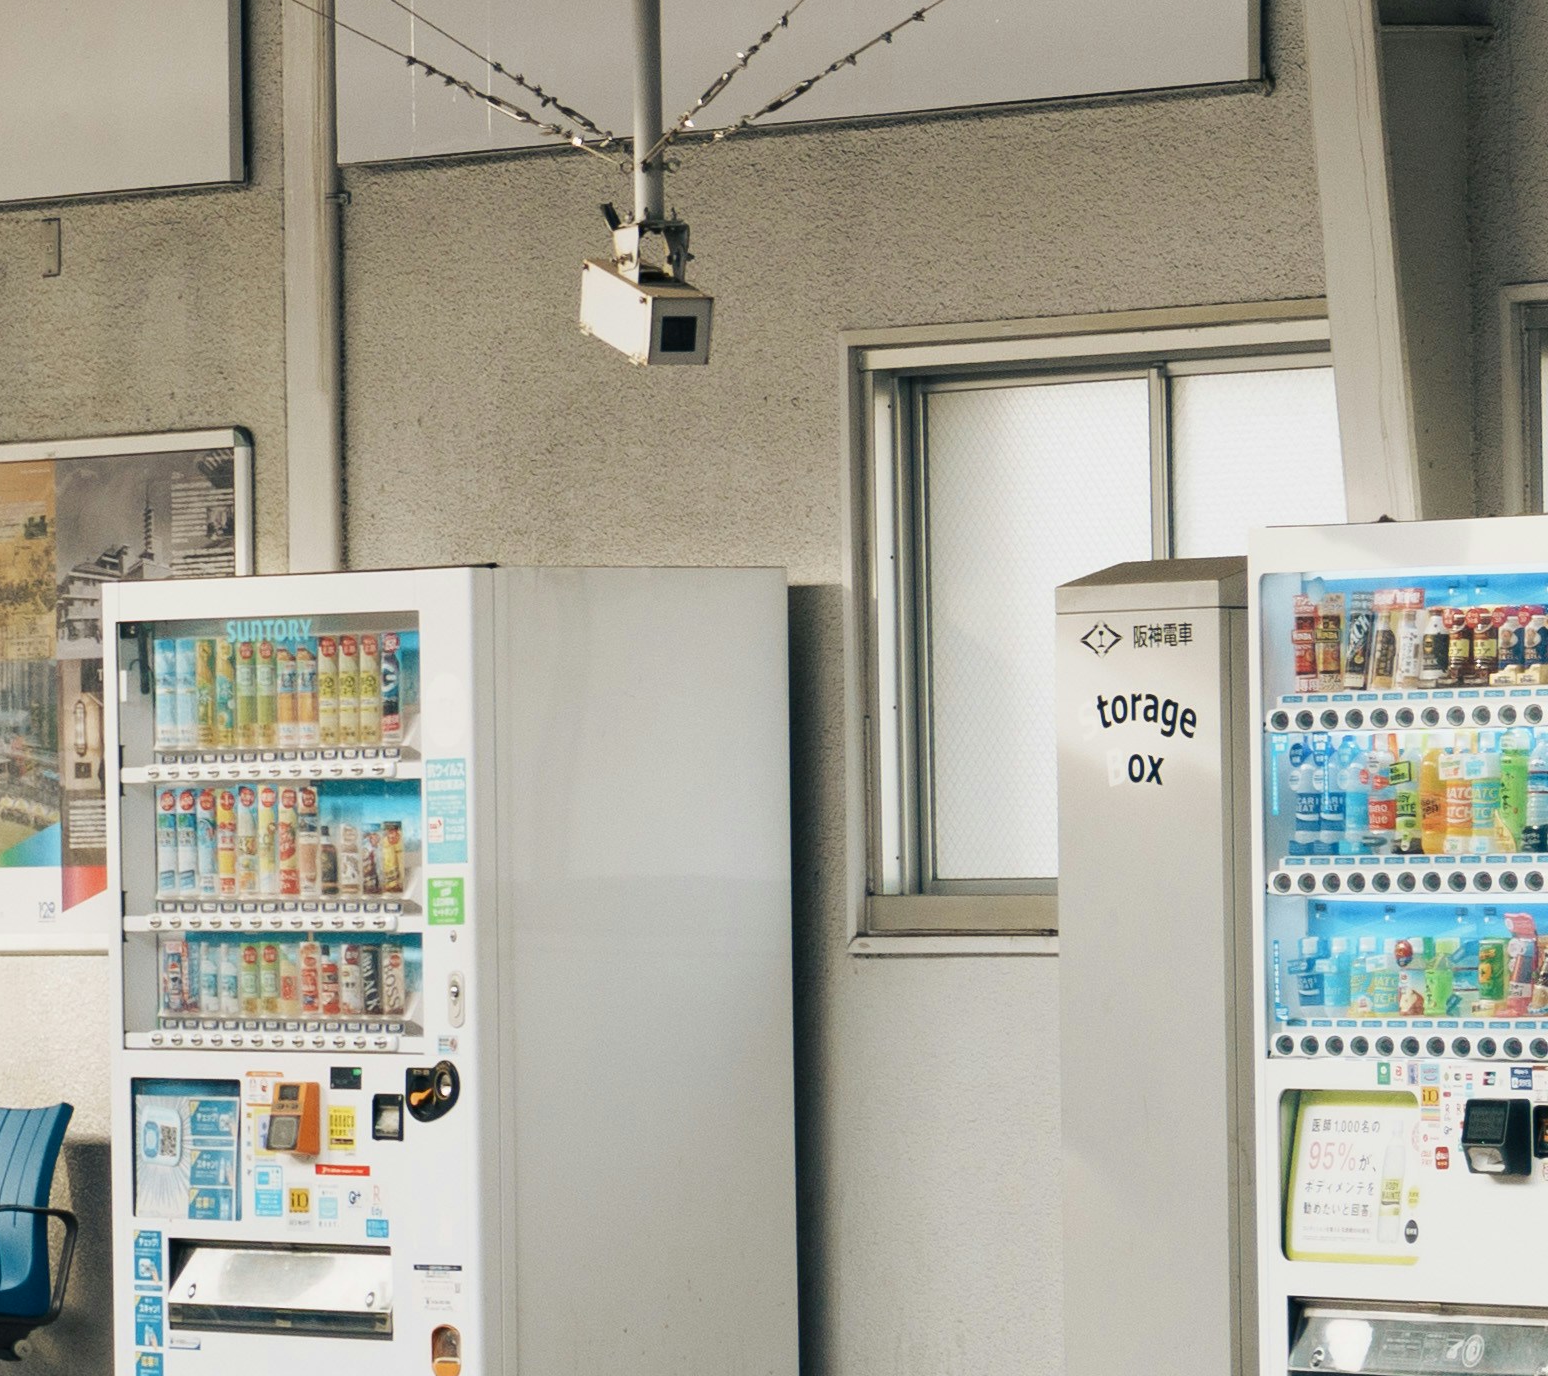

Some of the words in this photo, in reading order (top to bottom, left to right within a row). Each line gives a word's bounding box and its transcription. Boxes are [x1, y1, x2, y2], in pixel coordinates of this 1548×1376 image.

[226, 619, 313, 644] SUNTORY
[1133, 621, 1194, 650] 阪神電車
[290, 1189, 310, 1209] iD
